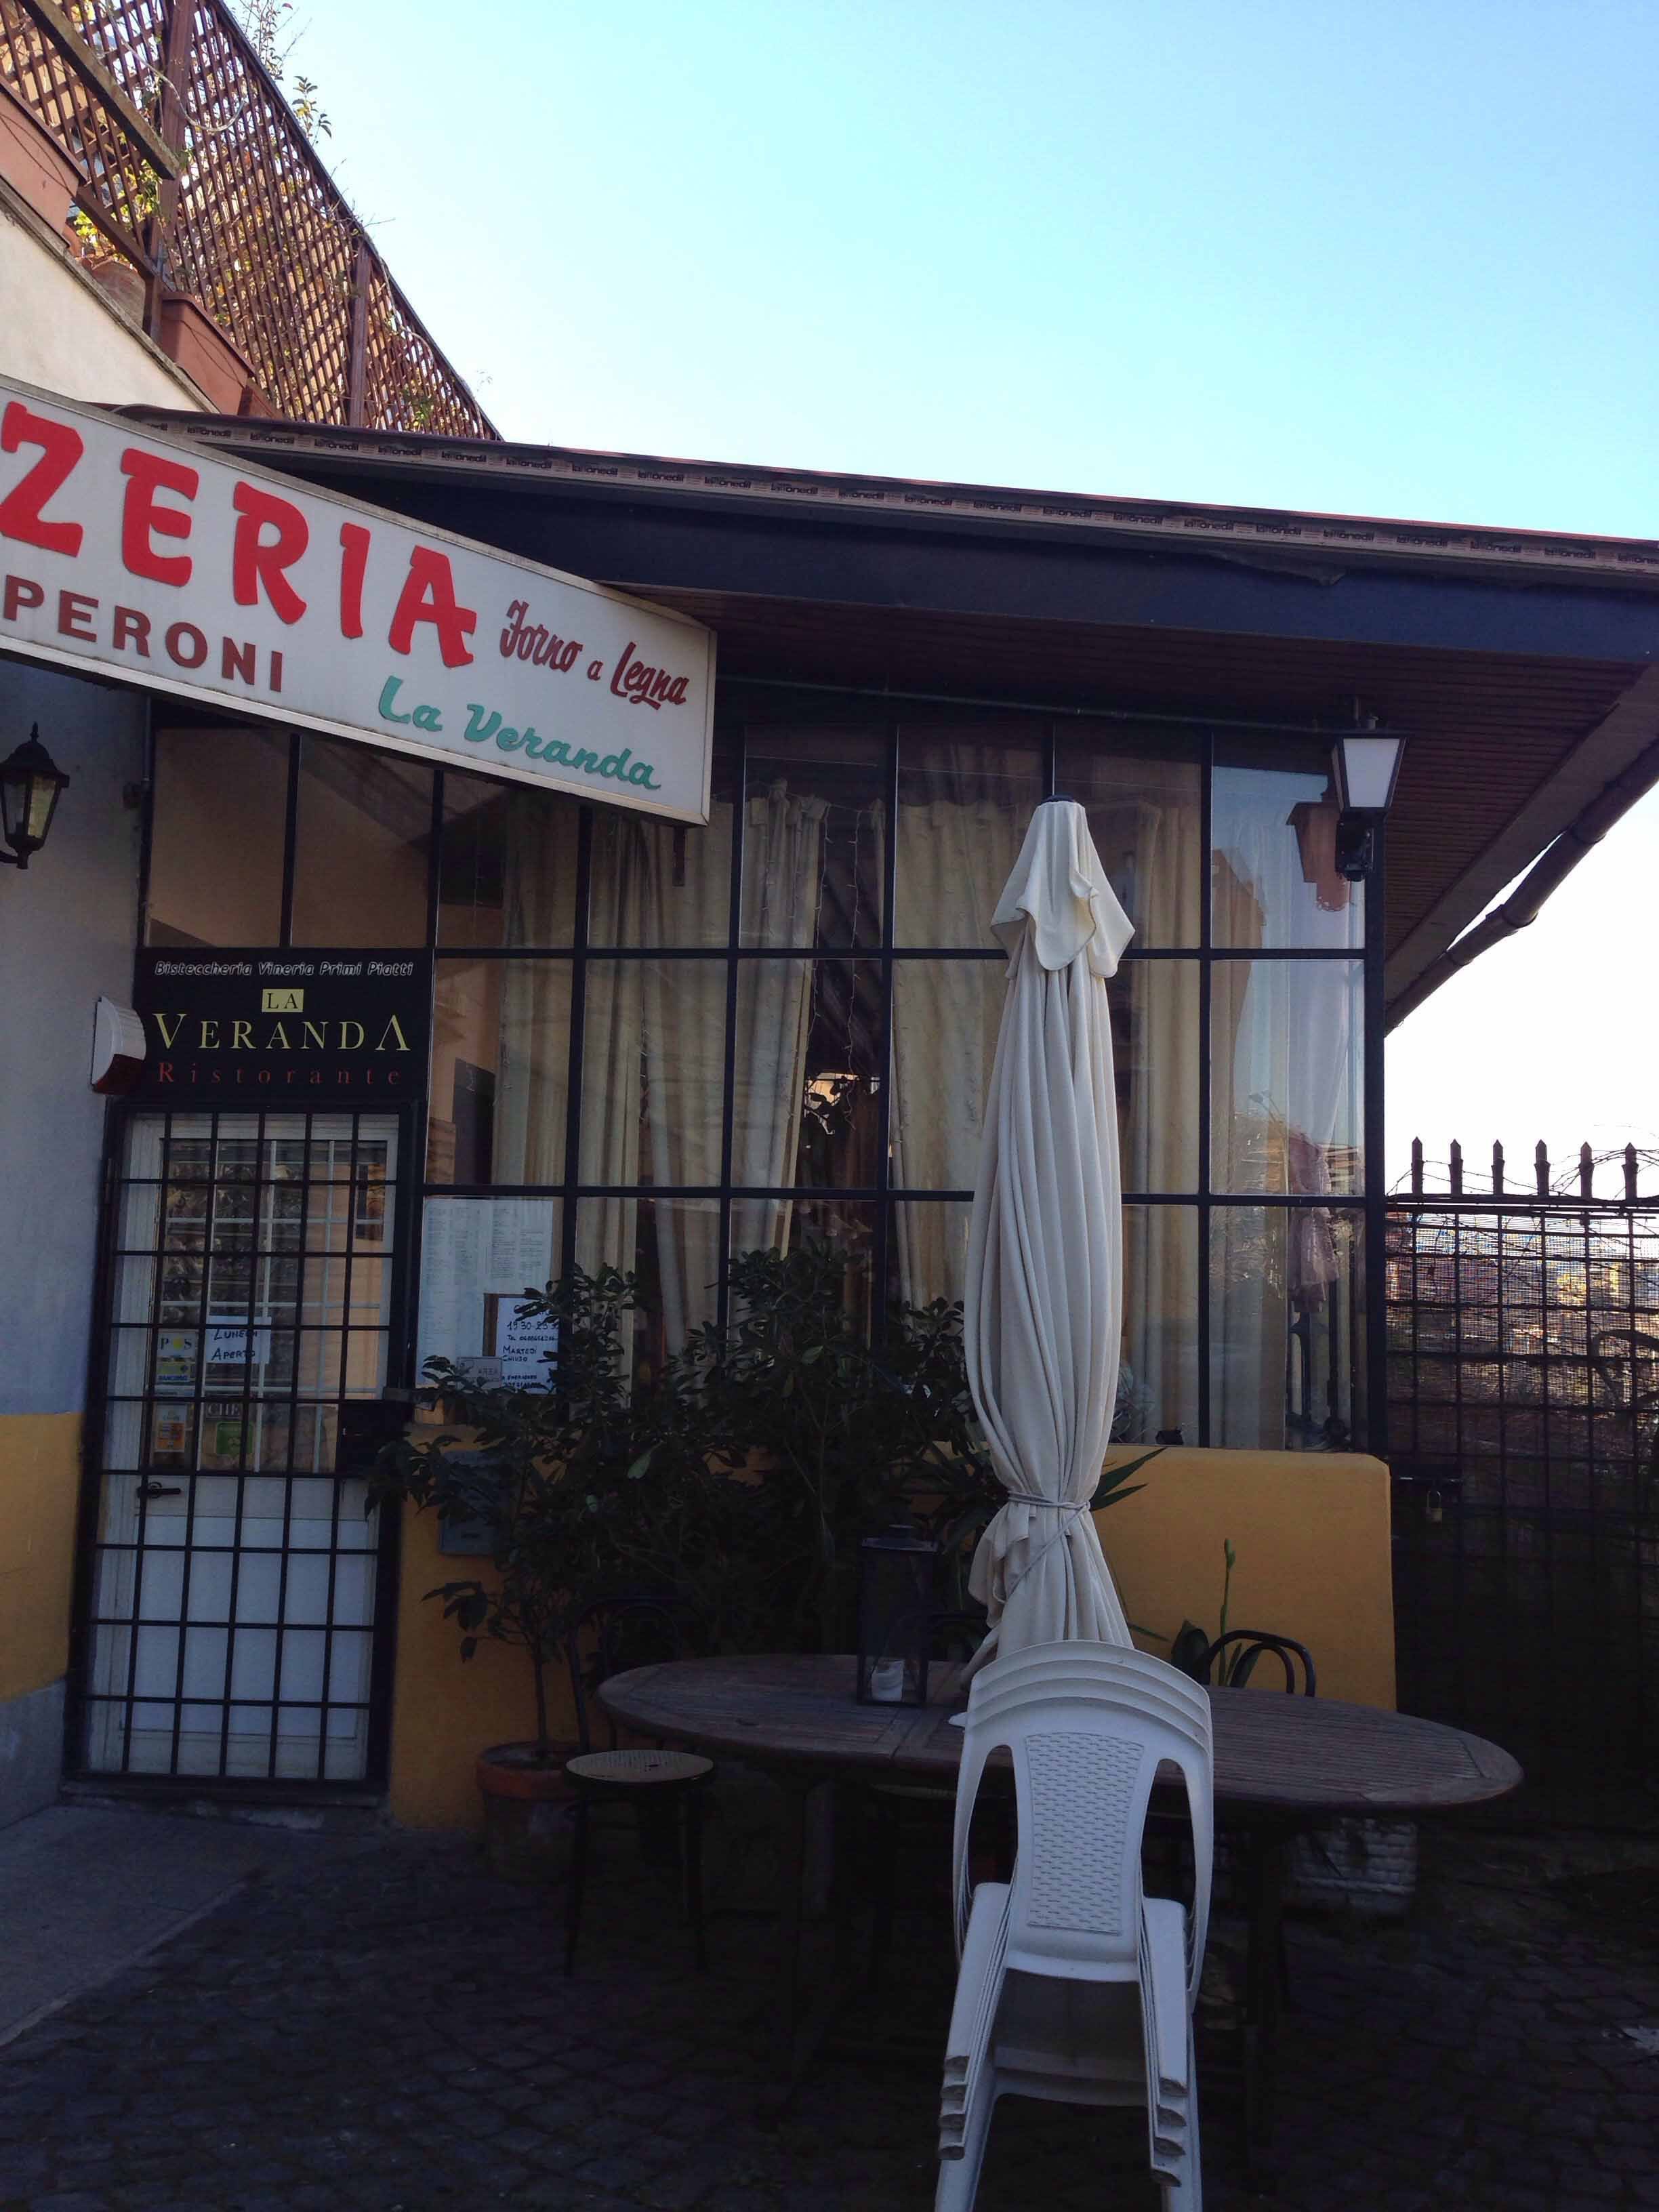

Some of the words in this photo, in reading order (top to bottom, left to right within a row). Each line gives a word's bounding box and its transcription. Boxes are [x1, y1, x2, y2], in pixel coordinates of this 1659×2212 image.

[0, 401, 476, 668] ZERIA
[3, 574, 283, 693] PERONI
[499, 598, 583, 675] Forno
[587, 659, 601, 681] a
[609, 642, 689, 710] Legna
[378, 675, 443, 731] La
[466, 703, 661, 791] Veranda
[155, 961, 252, 976] Bisteccheria
[258, 961, 314, 976] Vineria
[319, 961, 362, 976] Primi
[367, 961, 413, 976] Piatti
[266, 992, 299, 1010] LA
[152, 1013, 411, 1052] VERANDA
[159, 1061, 403, 1084] Ristorante
